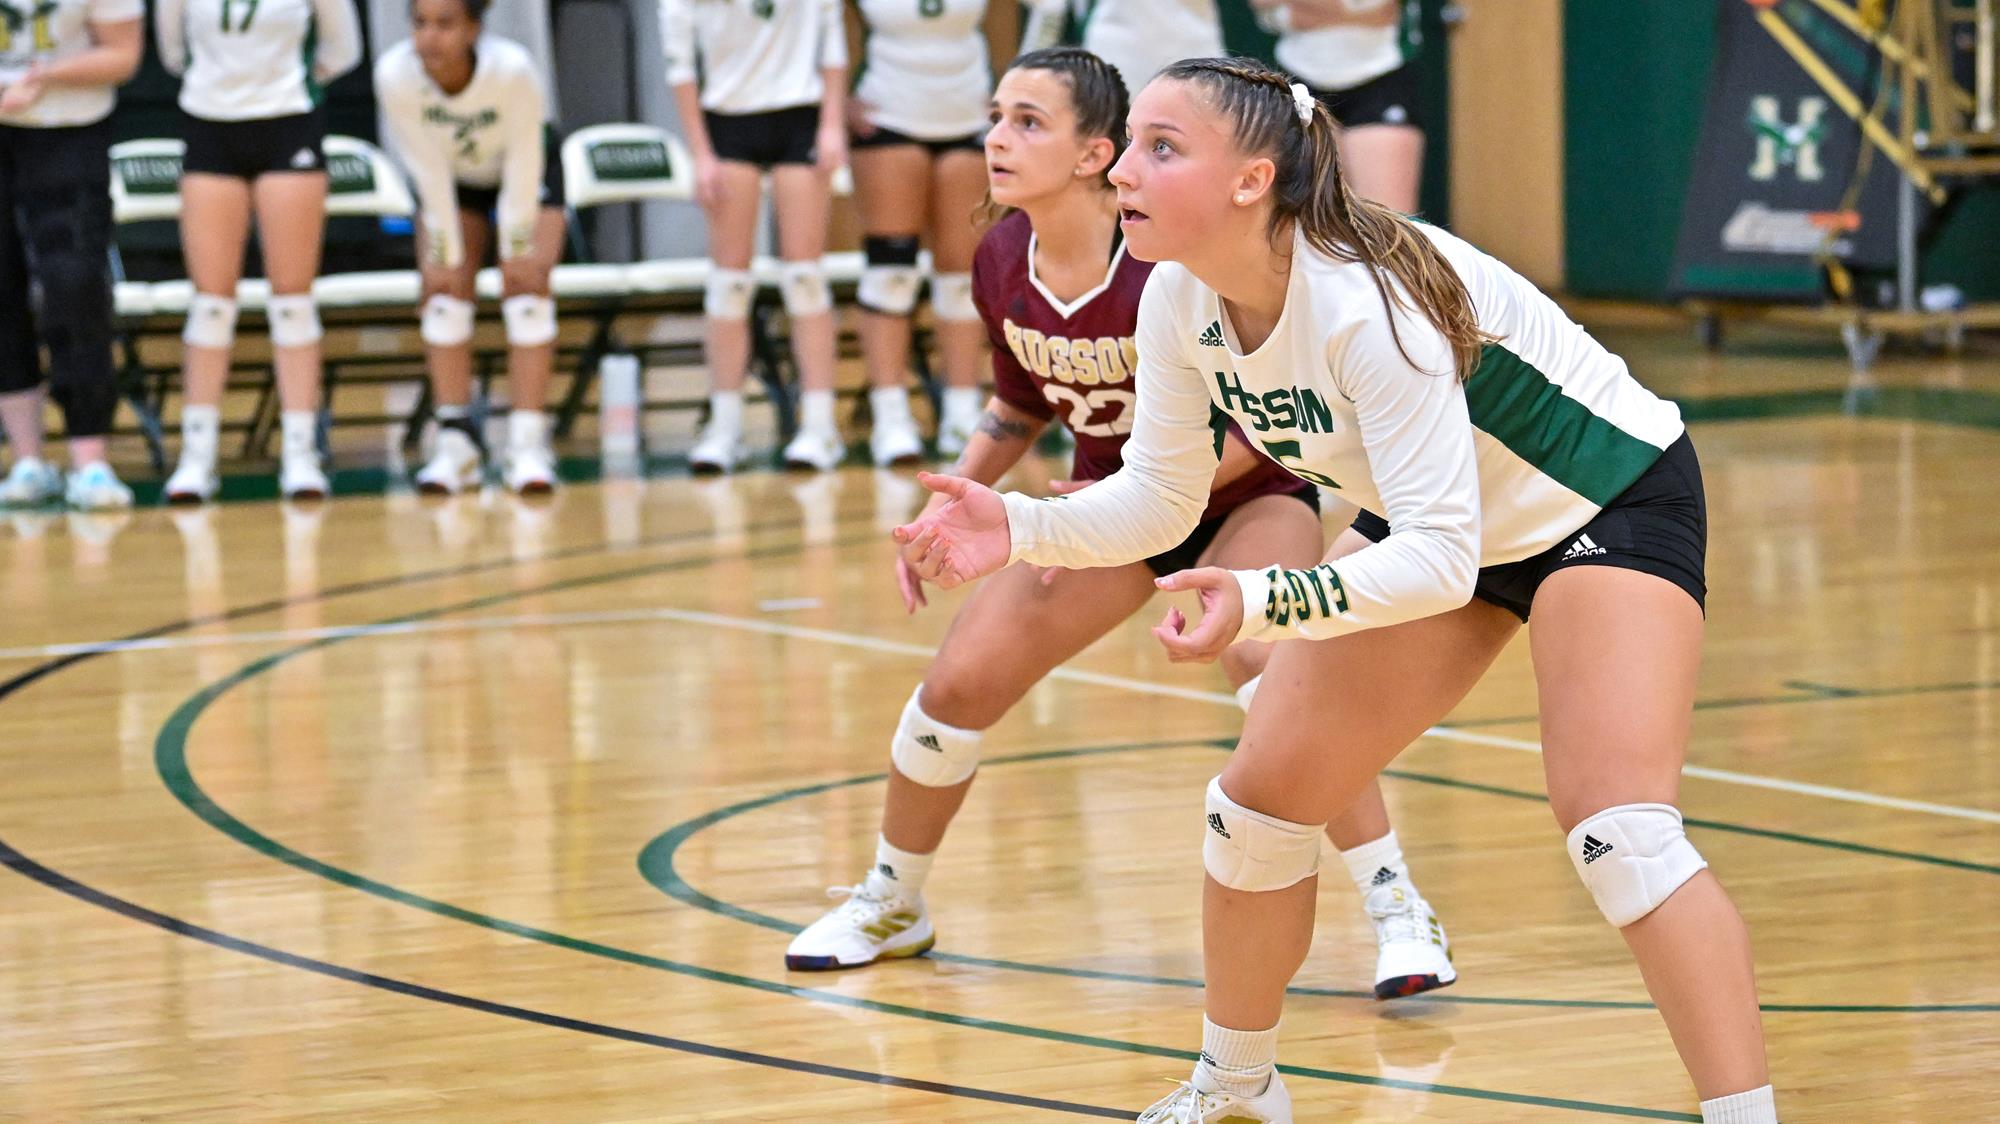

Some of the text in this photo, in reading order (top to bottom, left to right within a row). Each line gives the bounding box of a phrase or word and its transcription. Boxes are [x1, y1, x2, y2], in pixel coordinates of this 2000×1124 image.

[1042, 383, 1137, 437] 22
[1215, 371, 1334, 434] HSSON
[1583, 843, 1613, 865] adidas
